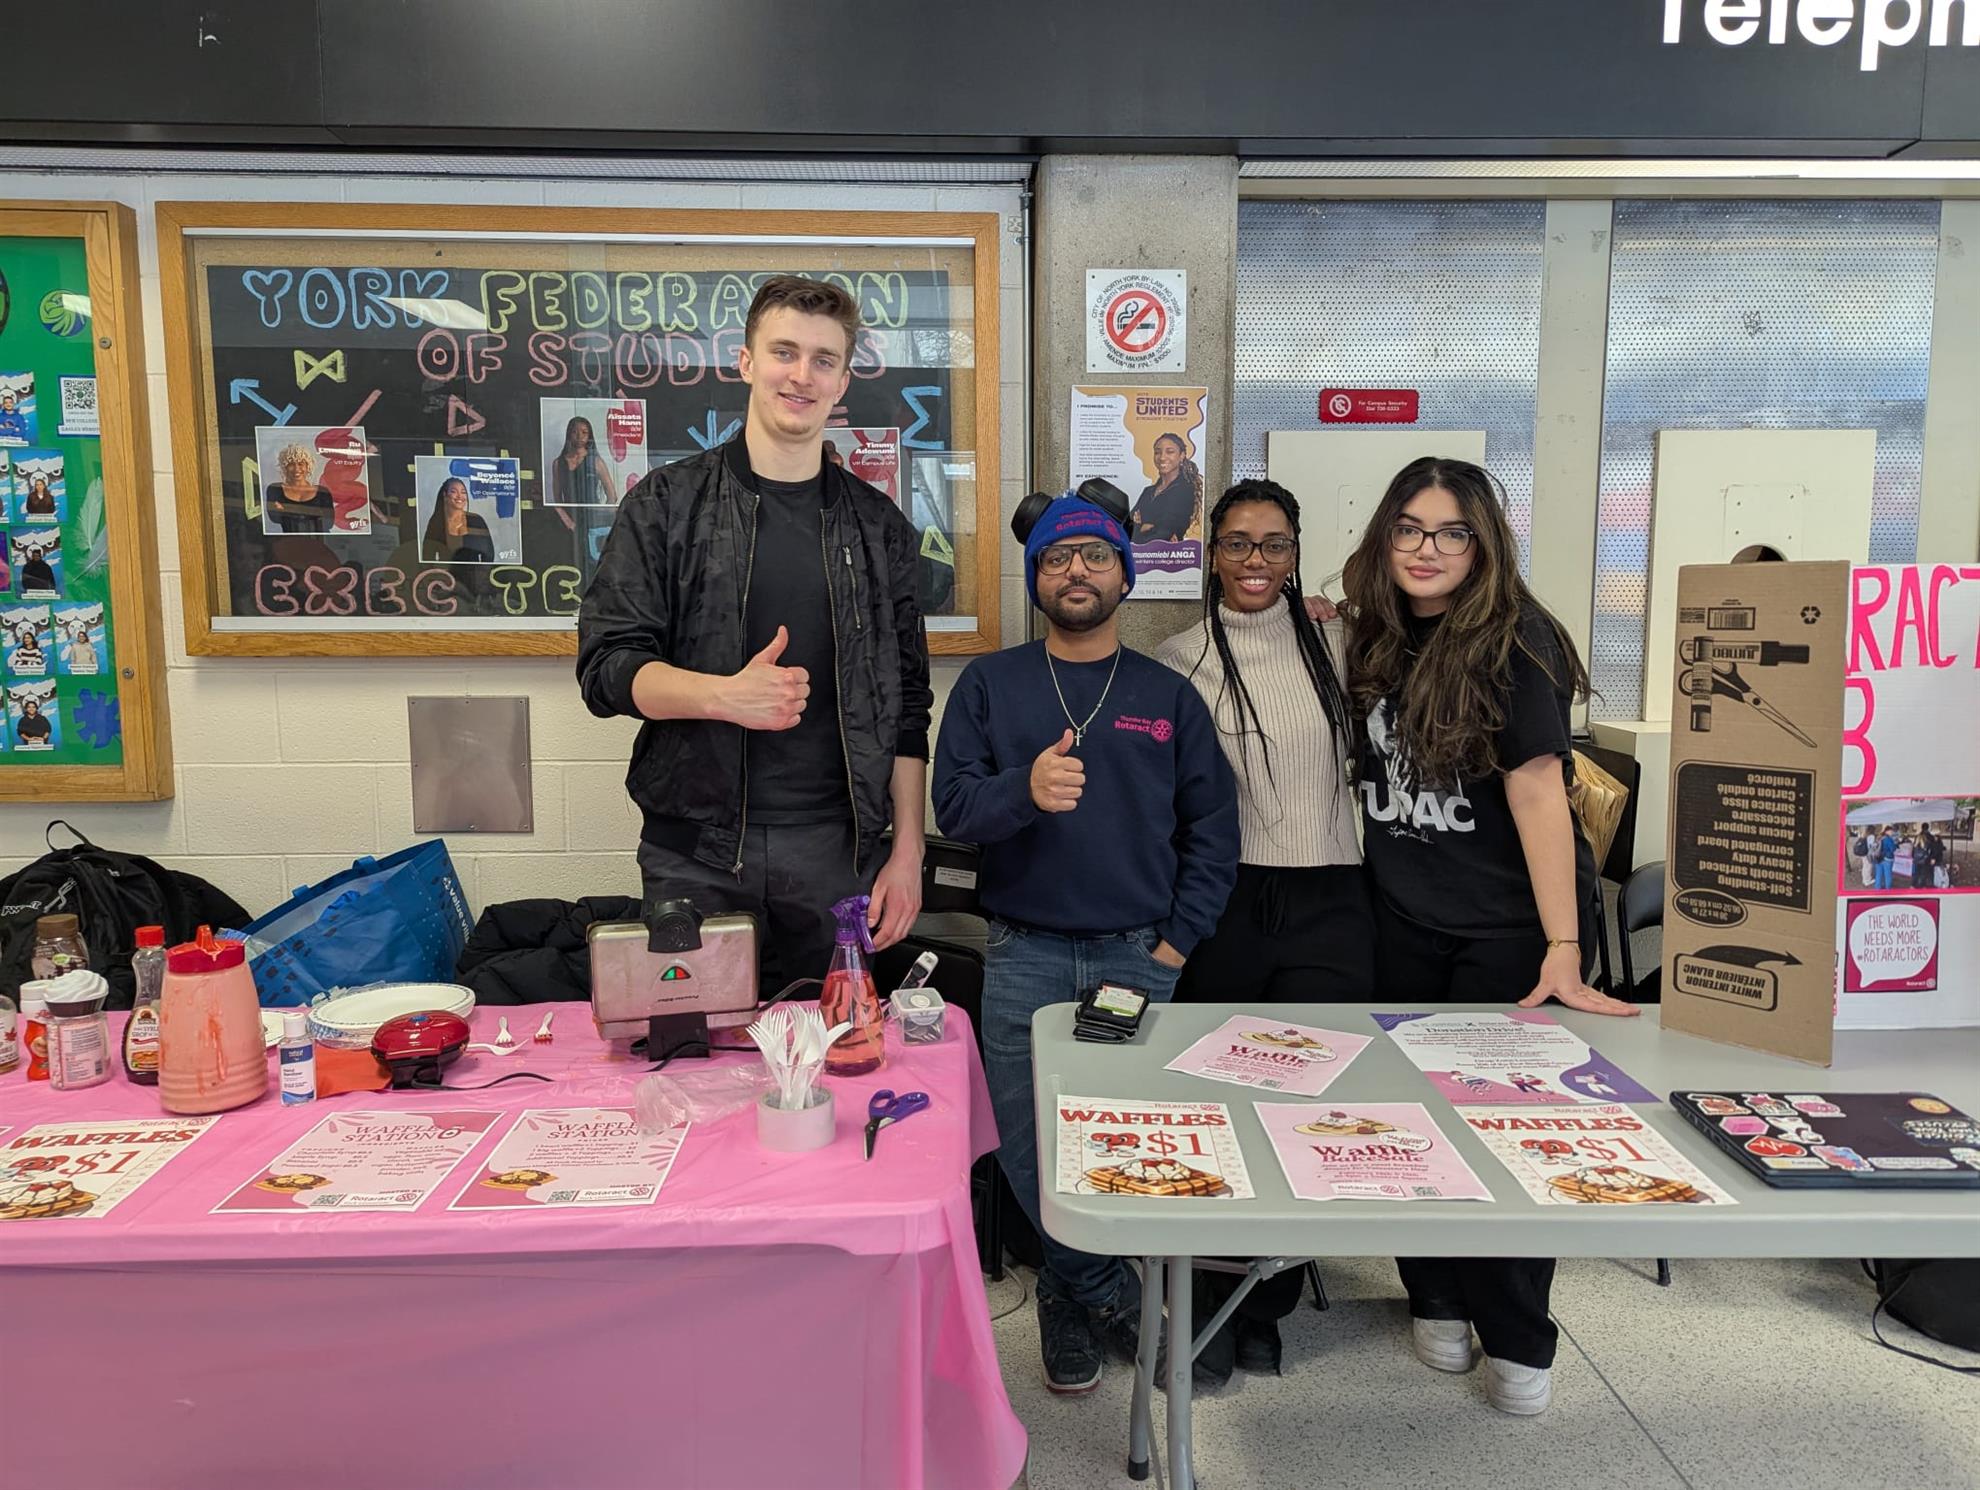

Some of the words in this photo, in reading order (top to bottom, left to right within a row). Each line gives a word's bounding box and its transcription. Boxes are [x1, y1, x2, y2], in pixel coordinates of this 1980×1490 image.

[1103, 279, 1122, 294] NORTH
[242, 268, 449, 329] YORK
[480, 270, 908, 333] FEDERAN
[1103, 290, 1118, 309] NORTH
[1119, 283, 1134, 292] YORK
[417, 328, 507, 383] OF
[528, 328, 887, 388] STUDES
[1136, 397, 1189, 406] STUDENTS
[1136, 406, 1189, 416] UNITED
[477, 471, 515, 479] Beyoncé
[1170, 551, 1196, 559] ANGA
[255, 564, 457, 616] EXEC
[1114, 720, 1151, 733] Rotaract
[1747, 774, 1797, 786] renforcé
[1717, 784, 1756, 795] ondulé
[1757, 787, 1796, 801] Carton
[1360, 780, 1476, 832] UPAC
[1722, 797, 1749, 809] lisse
[1751, 802, 1796, 814] Surface
[1731, 811, 1796, 826] nécessaire
[1714, 821, 1757, 833] support
[1759, 827, 1795, 840] Aucun
[1697, 835, 1729, 848] board
[1731, 840, 1794, 856] corrugated
[1732, 852, 1757, 864] duty
[1759, 857, 1794, 871] Heavy
[1699, 860, 1748, 875] surfaced
[1749, 867, 1794, 884] Smooth
[1718, 875, 1793, 897] Self-standing
[1868, 914, 1885, 929] THE
[1888, 914, 1919, 929] WORLD
[1864, 931, 1894, 946] NEEDS
[1896, 930, 1922, 945] MORE
[1683, 964, 1715, 978] BLANC
[1715, 968, 1766, 988] INTÉRIEUR
[1686, 976, 1730, 993] INTERIOR
[1730, 986, 1763, 1000] WHITE
[1060, 1108, 1227, 1126] WAFFLES
[1467, 1116, 1644, 1132] WAFFLES
[355, 1125, 441, 1134] WAFFLE
[547, 1129, 640, 1139] STATION
[9, 1128, 200, 1149] WAFFLES
[341, 1132, 437, 1142] STATION
[1146, 1130, 1213, 1156] $1
[1310, 1144, 1418, 1156] Waffle
[1576, 1136, 1657, 1162] $1
[58, 1150, 141, 1178] $1
